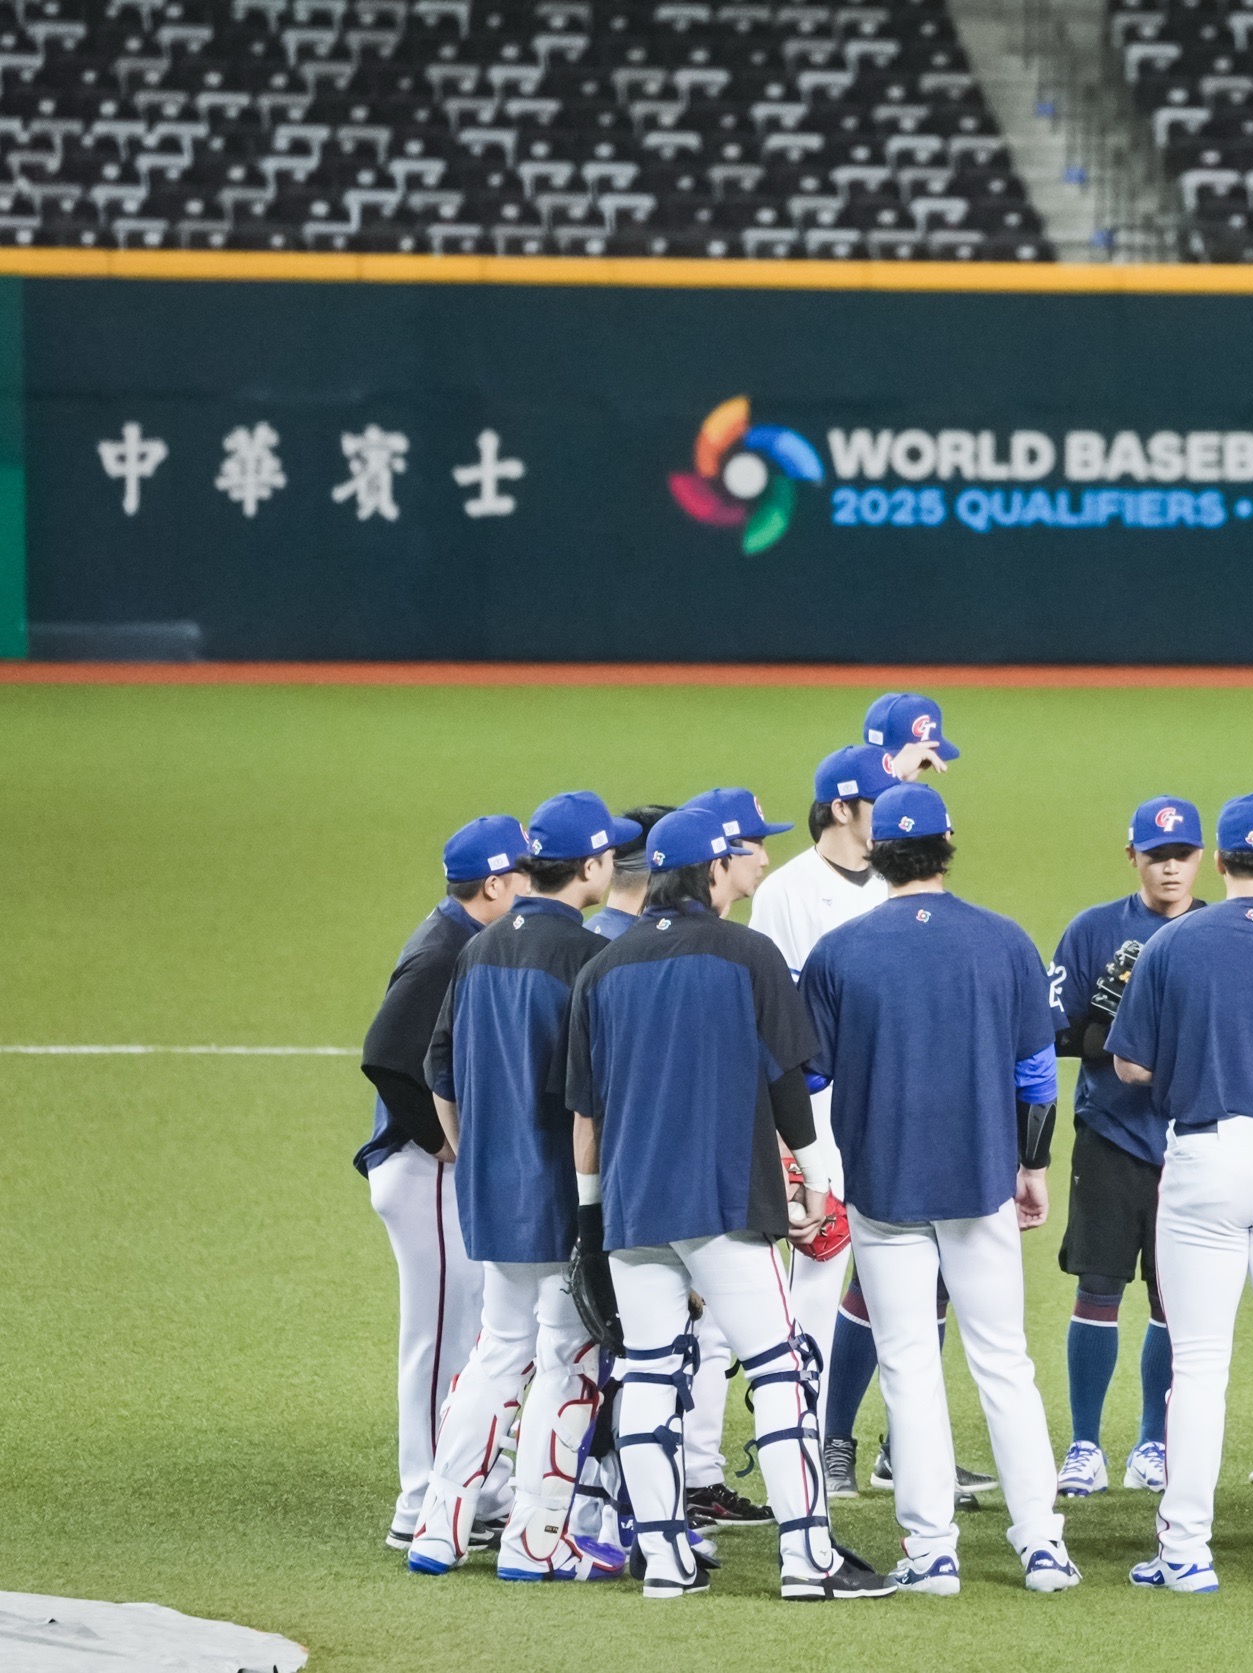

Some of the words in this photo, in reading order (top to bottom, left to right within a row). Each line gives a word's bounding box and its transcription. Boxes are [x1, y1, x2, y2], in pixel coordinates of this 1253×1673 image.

[97, 421, 526, 522] 中華賓士
[827, 427, 1057, 482] WORLD
[830, 486, 947, 528] 2025
[954, 487, 1228, 533] QUALIFIERS
